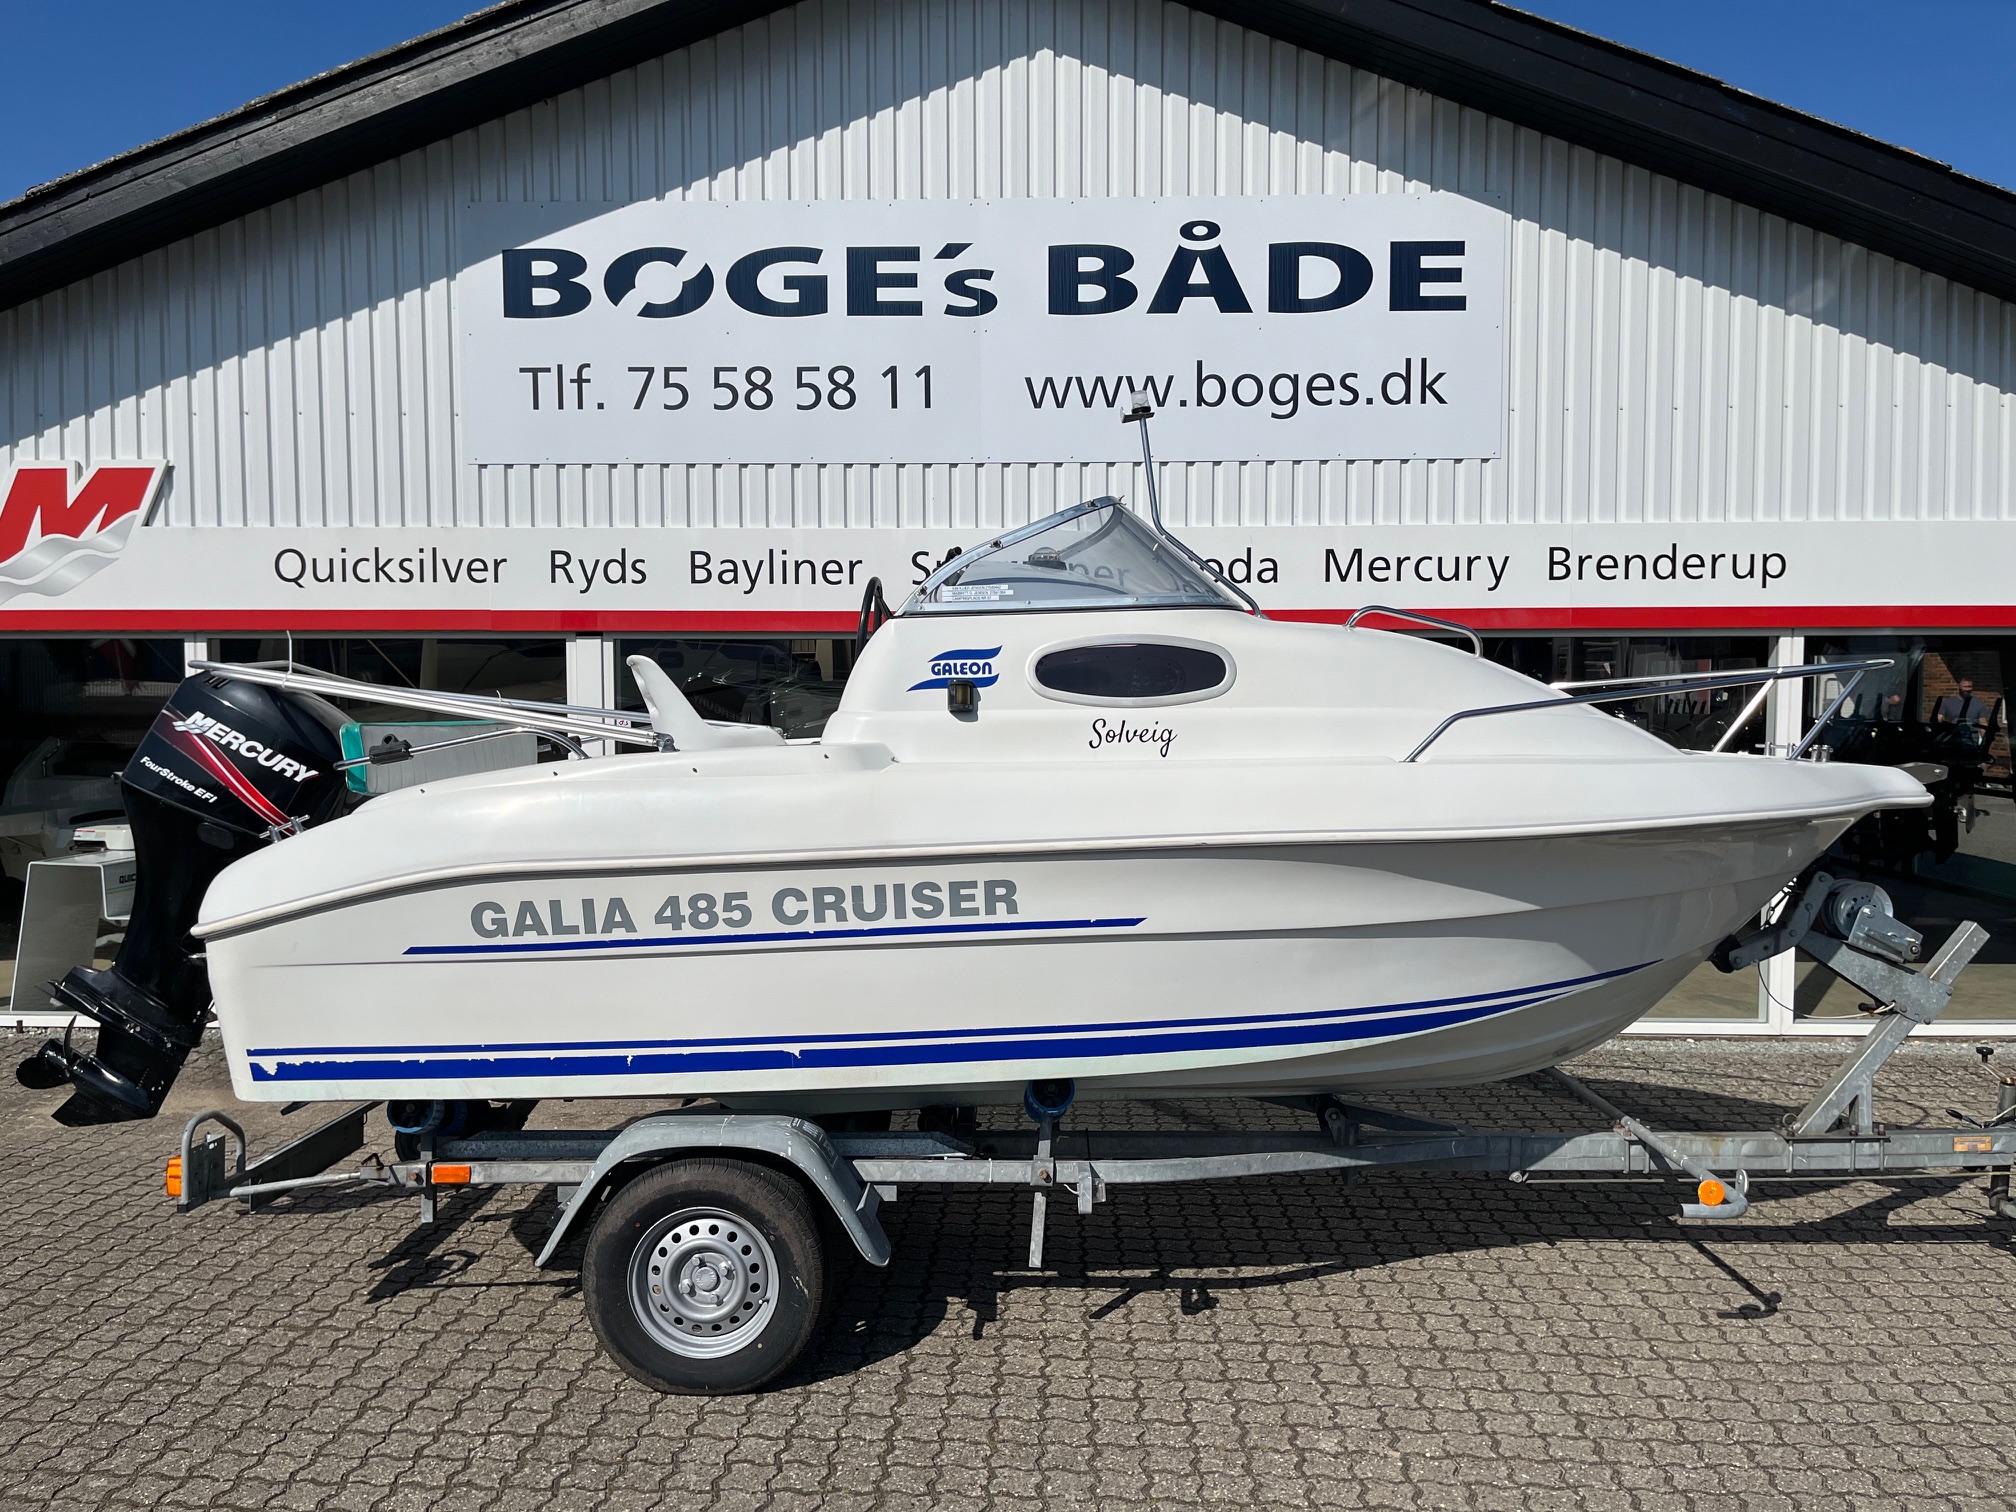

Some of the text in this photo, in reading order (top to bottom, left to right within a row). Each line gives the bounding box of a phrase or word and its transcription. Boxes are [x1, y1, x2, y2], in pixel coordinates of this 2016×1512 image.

[1048, 220, 1467, 316] BÅDE
[518, 362, 932, 411] Tlf. 75 58 58 11
[1024, 357, 1448, 420] www.boges.dk
[274, 546, 508, 589] Quicksilver
[550, 547, 647, 594] Ryds
[690, 549, 863, 595] Bayliner
[1325, 548, 1510, 592] Mercury
[1548, 542, 1787, 589] Brenderup
[929, 661, 994, 677] GALEON
[174, 711, 320, 783] MERCURY
[1088, 718, 1178, 758] Solveig
[140, 756, 218, 804] FourStroke EFI
[470, 878, 1020, 939] GALIA 485 CRUISER
